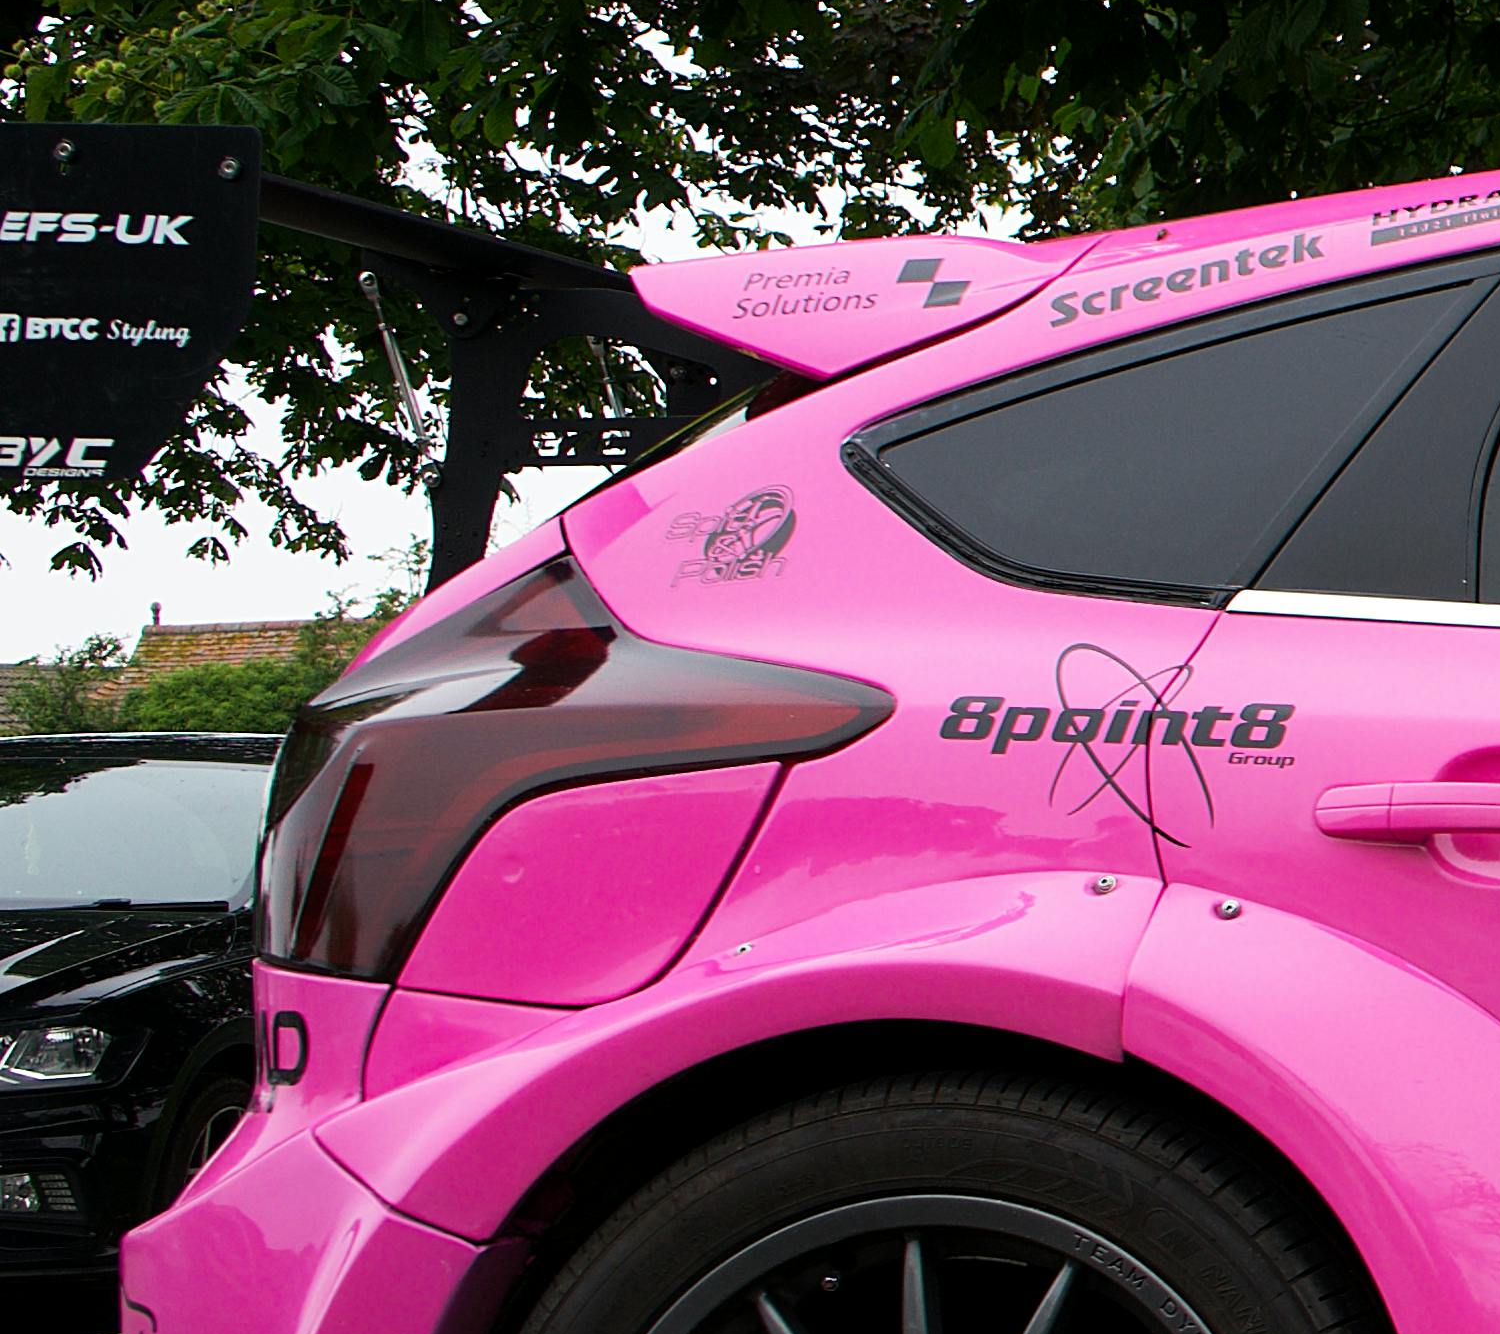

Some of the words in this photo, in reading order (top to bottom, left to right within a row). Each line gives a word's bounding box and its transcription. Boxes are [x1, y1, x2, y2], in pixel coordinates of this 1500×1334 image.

[744, 267, 851, 292] Premia
[1049, 231, 1326, 328] Screentek
[732, 288, 877, 321] Solutions
[26, 317, 100, 341] BTCC
[107, 319, 192, 348] Styling
[668, 552, 788, 588] Polish
[939, 696, 1295, 755] 8point8
[1228, 752, 1295, 769] Group
[1073, 1231, 1147, 1291] TEAM
